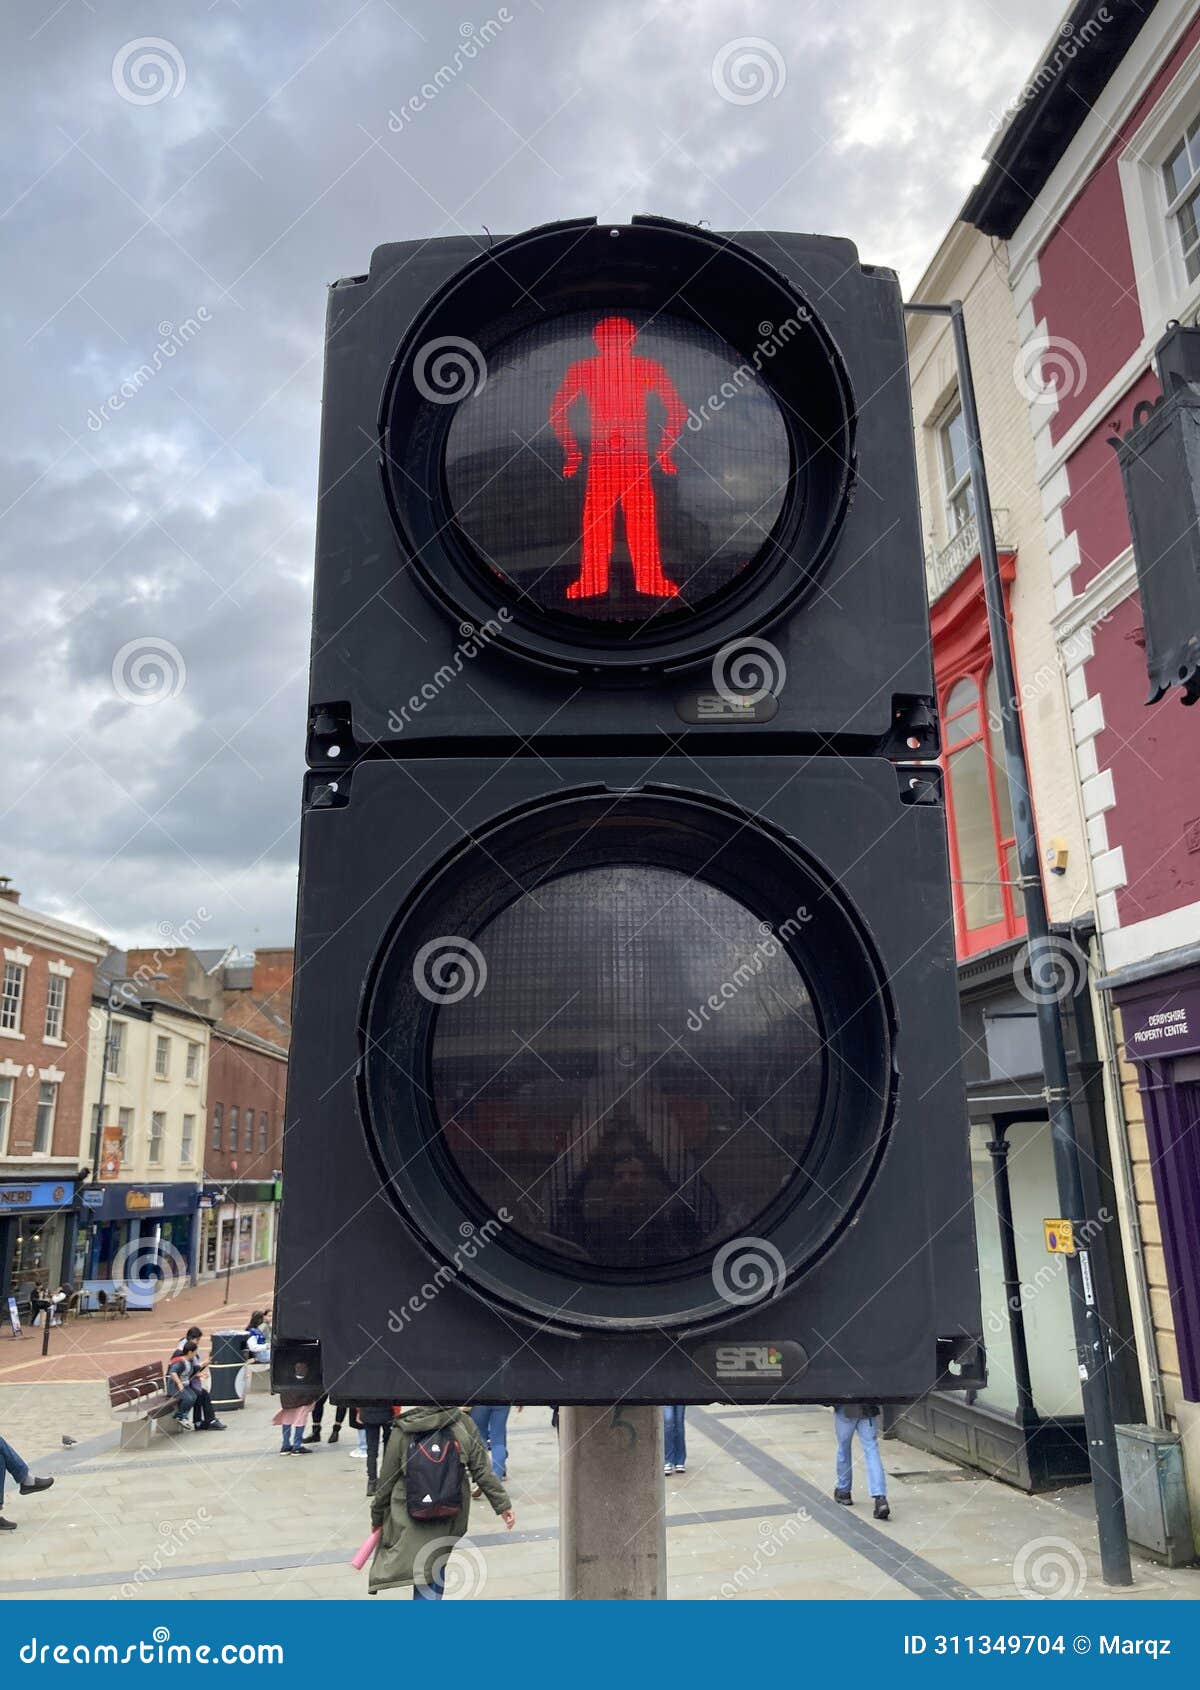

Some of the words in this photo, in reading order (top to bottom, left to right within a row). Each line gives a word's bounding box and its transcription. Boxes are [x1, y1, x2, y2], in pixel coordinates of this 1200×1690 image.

[1148, 1008, 1187, 1026] DERBYSHIRE
[1134, 1027, 1163, 1042] PROPERTY
[1164, 1022, 1189, 1037] CENTRE
[716, 1347, 782, 1370] SRL
